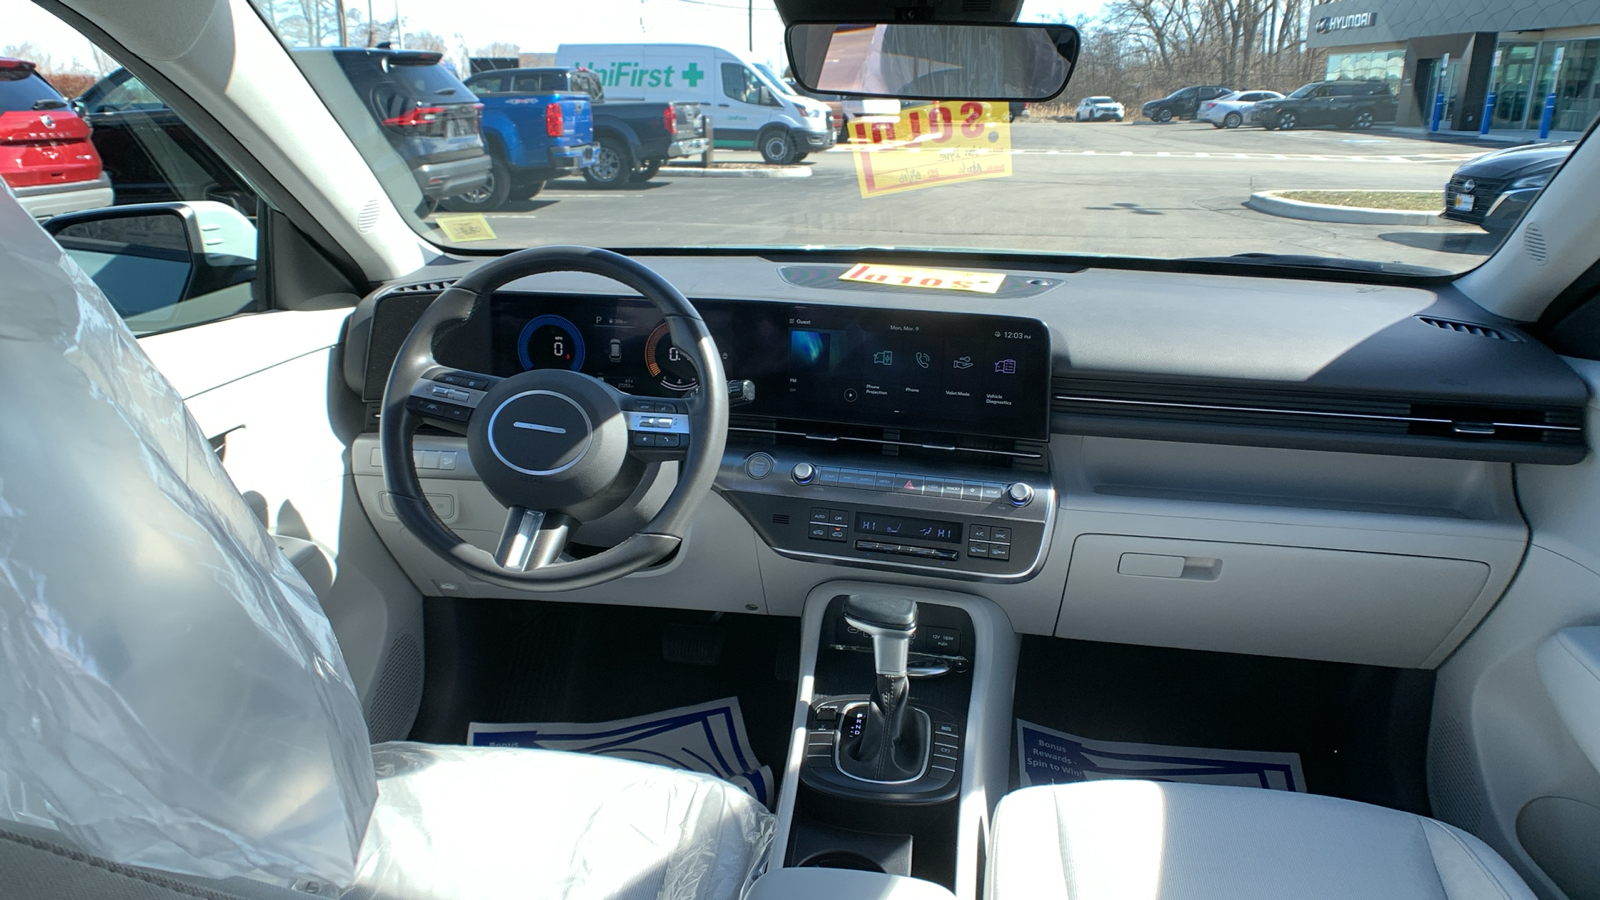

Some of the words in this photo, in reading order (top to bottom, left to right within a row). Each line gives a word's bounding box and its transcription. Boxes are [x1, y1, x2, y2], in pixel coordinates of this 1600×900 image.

[1329, 12, 1373, 30] HYUNDAI
[596, 316, 602, 324] P
[1004, 331, 1023, 339] 12:03
[554, 341, 563, 356] 0
[1038, 739, 1067, 753] Bonus
[1032, 748, 1072, 764] Rewards
[1027, 757, 1048, 768] Spin
[1049, 763, 1060, 771] to
[1061, 765, 1083, 777] Win!
